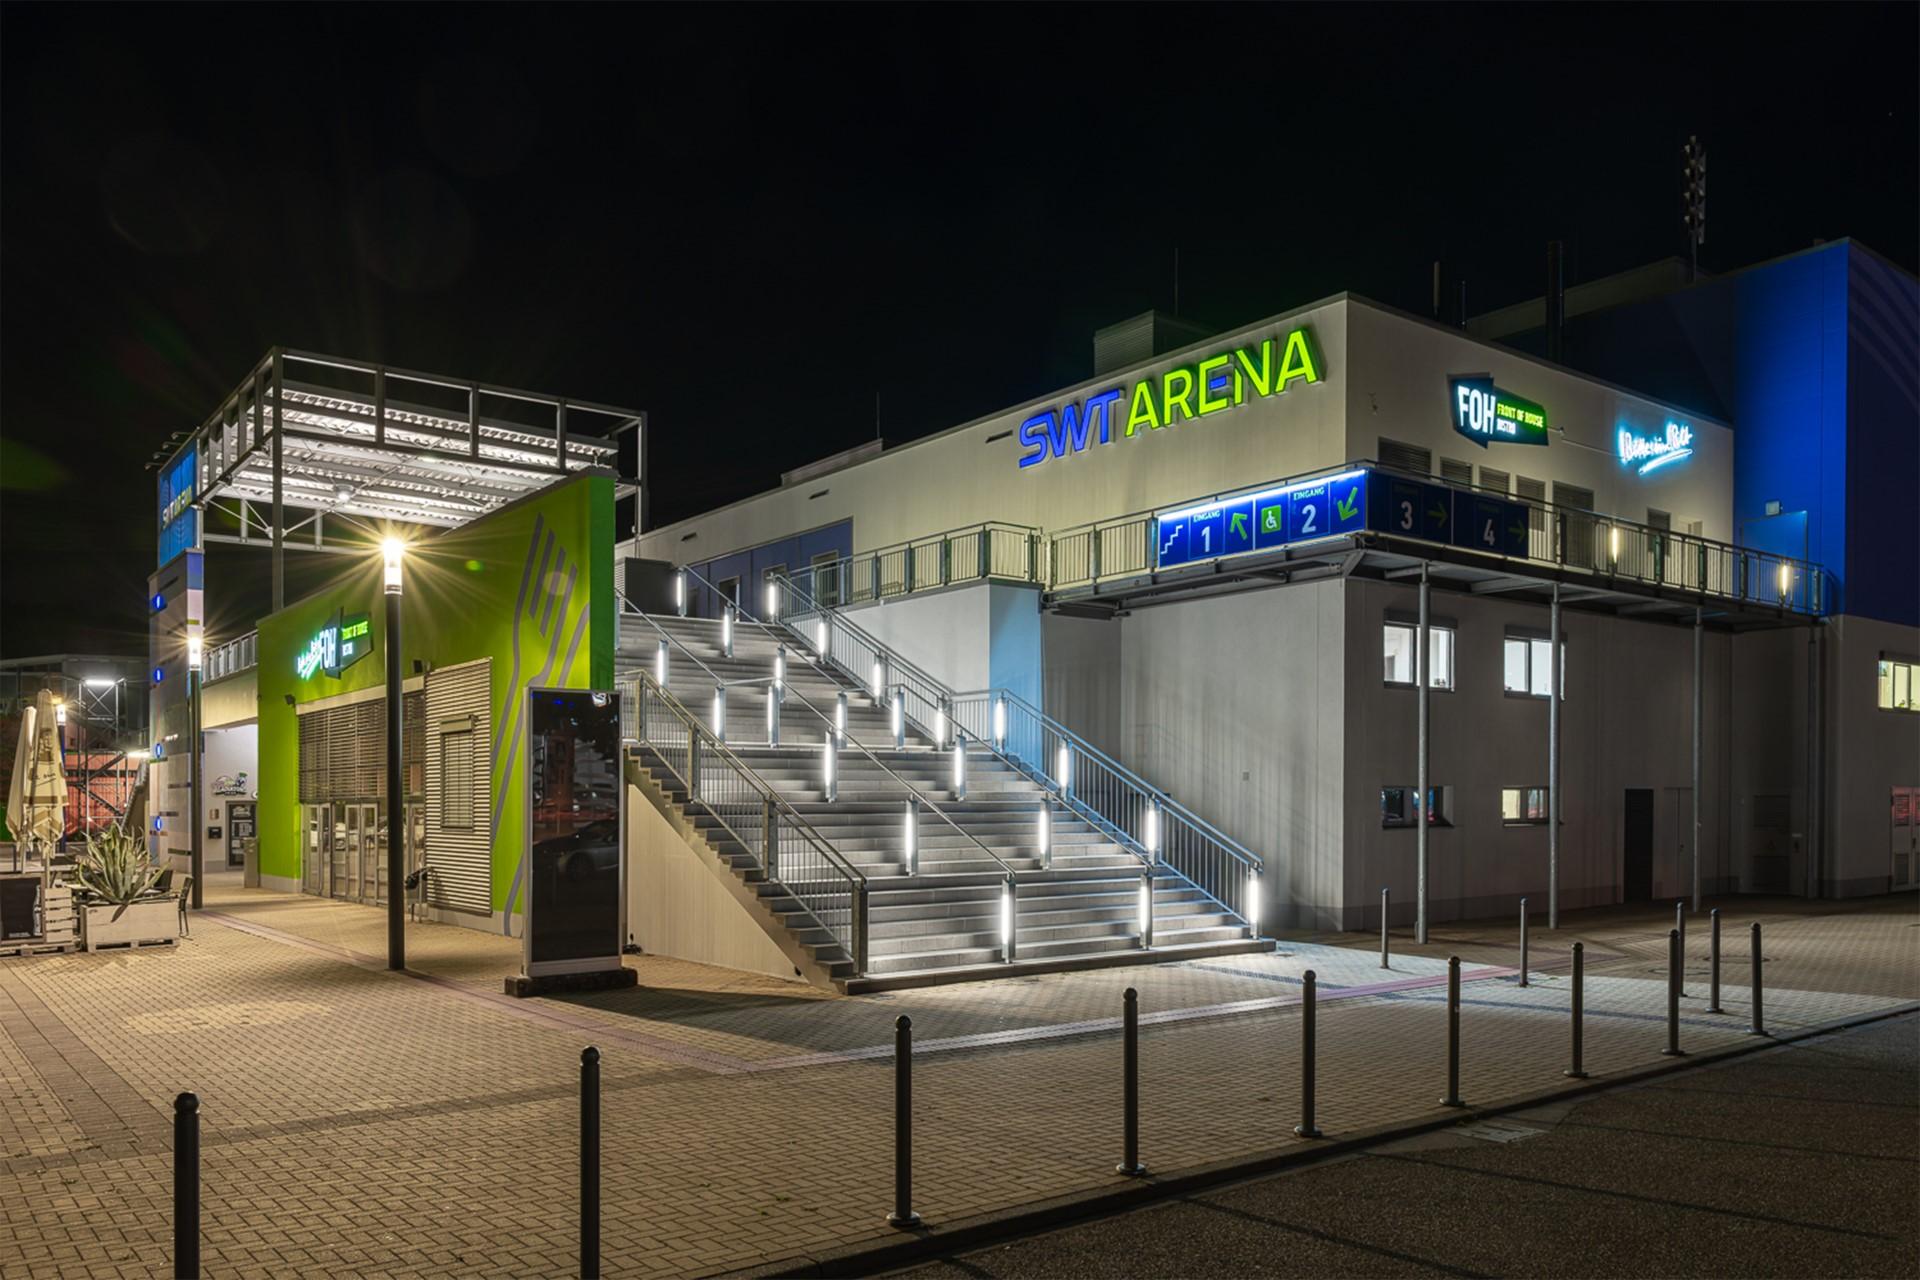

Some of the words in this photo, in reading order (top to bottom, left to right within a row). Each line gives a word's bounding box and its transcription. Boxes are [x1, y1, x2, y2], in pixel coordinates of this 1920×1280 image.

[1019, 389, 1121, 468] SWT
[1125, 329, 1318, 438] ARENA
[1457, 385, 1497, 435] FOH
[1293, 486, 1325, 501] EINGANG
[1193, 510, 1221, 523] EINGANG
[1301, 503, 1317, 534] 2
[1400, 499, 1414, 531] 3
[1201, 525, 1211, 552] 1
[1483, 517, 1496, 547] 4
[319, 627, 337, 670] FOH
